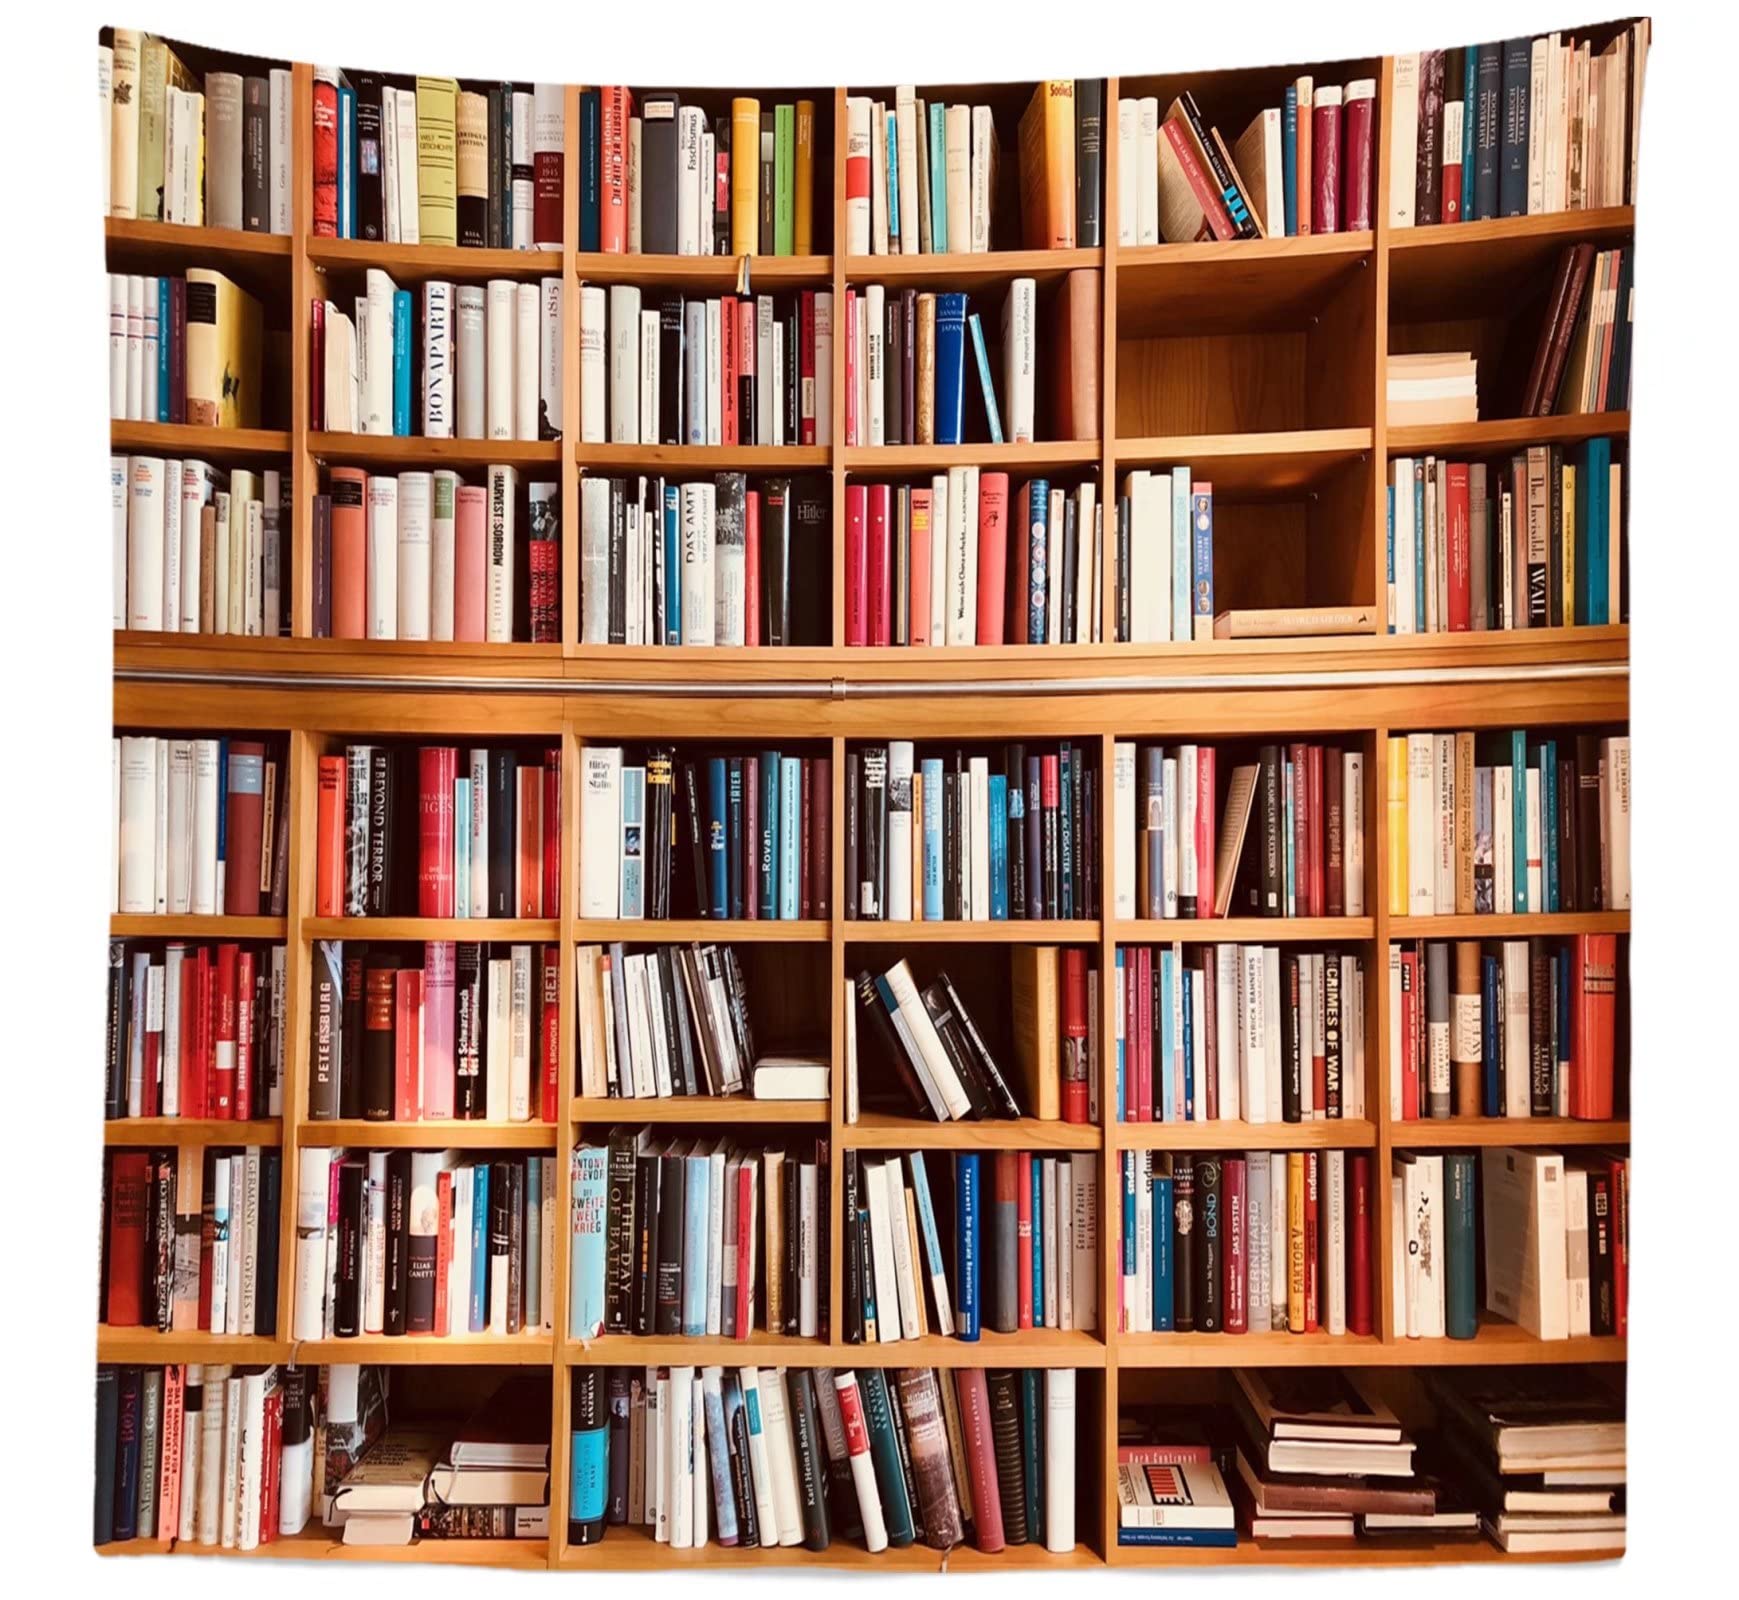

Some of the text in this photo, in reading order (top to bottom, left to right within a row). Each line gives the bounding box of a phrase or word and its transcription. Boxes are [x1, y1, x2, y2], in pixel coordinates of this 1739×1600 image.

[687, 113, 697, 170] Faschismus
[1424, 128, 1434, 151] isha
[1478, 92, 1488, 150] JAHRBUCH
[1507, 87, 1517, 144] JAHRBUCH
[1518, 87, 1526, 143] YEARBOOK
[612, 142, 622, 163] DER
[1190, 116, 1207, 140] DOWN
[1211, 155, 1232, 186] OLYMPUS
[612, 188, 622, 206] DIE
[549, 285, 559, 318] 1815
[428, 287, 446, 423] BONAPARTE
[493, 475, 504, 567] HARVEST SORROW
[685, 488, 696, 564] DAS AMT
[797, 504, 827, 521] Hitler
[1531, 474, 1545, 618] The Invisible WALL
[957, 597, 965, 620] Wenn
[588, 761, 611, 770] Hitler
[588, 780, 611, 790] Stalin
[592, 771, 607, 779] und
[1296, 749, 1304, 833] TERRA ISLAMICA
[372, 771, 385, 883] BEYOND TERROR
[762, 830, 772, 872] Rovan
[1063, 830, 1071, 874] DISASTER
[1328, 806, 1342, 868] Der große Türke
[545, 966, 557, 1002] RED
[1248, 957, 1257, 1048] PATRICK BAHNERS
[318, 982, 331, 1083] PETERSBURG
[458, 989, 469, 1076] Das Schwarzbuch
[1326, 967, 1339, 1091] CRIMES OF WAR
[468, 1057, 479, 1076] des
[549, 1066, 557, 1084] BILL
[1532, 1043, 1542, 1095] JONATHAN
[1541, 1046, 1549, 1095] SCHELL
[572, 1158, 604, 1169] ANTONY
[1307, 1152, 1318, 1201] campus
[571, 1197, 604, 1209] ZWEITE
[573, 1221, 601, 1234] KRIEG
[576, 1209, 599, 1221] WELT
[847, 1186, 857, 1222] Tories
[1075, 1183, 1086, 1250] George Packer
[1086, 1183, 1096, 1250] Die Abwicklung
[1206, 1193, 1217, 1238] BOND
[1231, 1195, 1240, 1255] DAS SYSTEM
[243, 1159, 257, 1309] GERMANY GYPSIES
[375, 1223, 384, 1284] FREIE WELT
[608, 1187, 621, 1305] OF BATTLE
[620, 1201, 633, 1293] THE DAY
[964, 1230, 973, 1259] digitale
[1248, 1200, 1260, 1307] BERNHARD
[1292, 1227, 1304, 1294] FAKTOR V
[408, 1270, 436, 1278] CANETTI
[413, 1262, 431, 1270] ELIAS
[1261, 1222, 1270, 1307] GRZIMEK
[587, 1372, 595, 1425] LANZMANN
[866, 1377, 883, 1430] SENIOR
[872, 1373, 888, 1431] SERVICE
[970, 1386, 982, 1446] Königsberg
[141, 1384, 157, 1514] Mario Frank Gauck
[164, 1408, 173, 1453] NEUSTART
[172, 1407, 180, 1455] HANDBUCH
[798, 1412, 816, 1506] Karl Heinz Bohrer
[1128, 1451, 1197, 1464] Dark Continent
